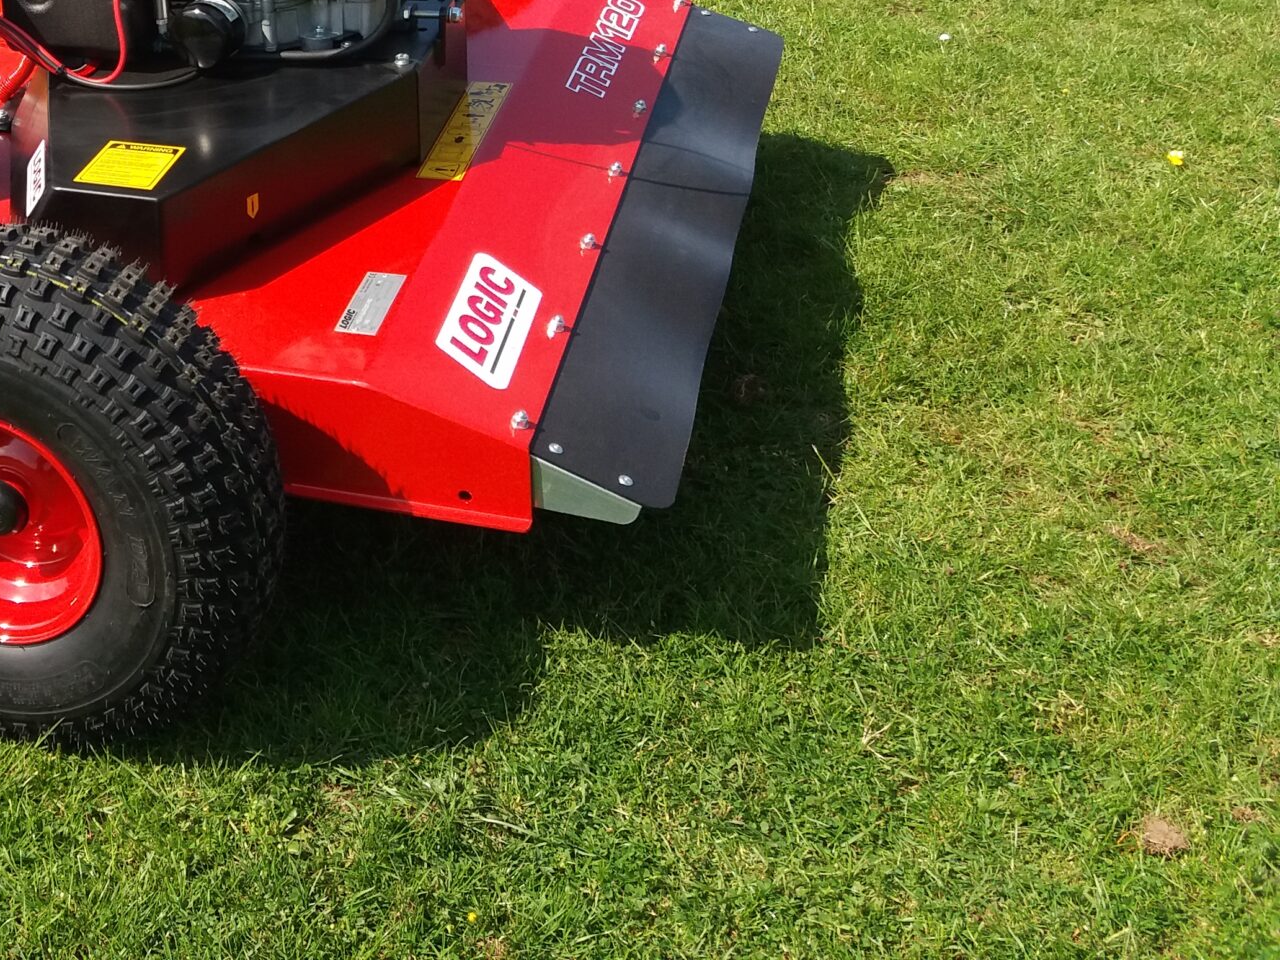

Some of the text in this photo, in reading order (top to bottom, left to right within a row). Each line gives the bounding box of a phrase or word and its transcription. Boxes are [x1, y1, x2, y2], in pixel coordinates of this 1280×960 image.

[129, 144, 174, 154] WARNING
[339, 308, 355, 329] LOGIC
[449, 266, 516, 367] LOGIC
